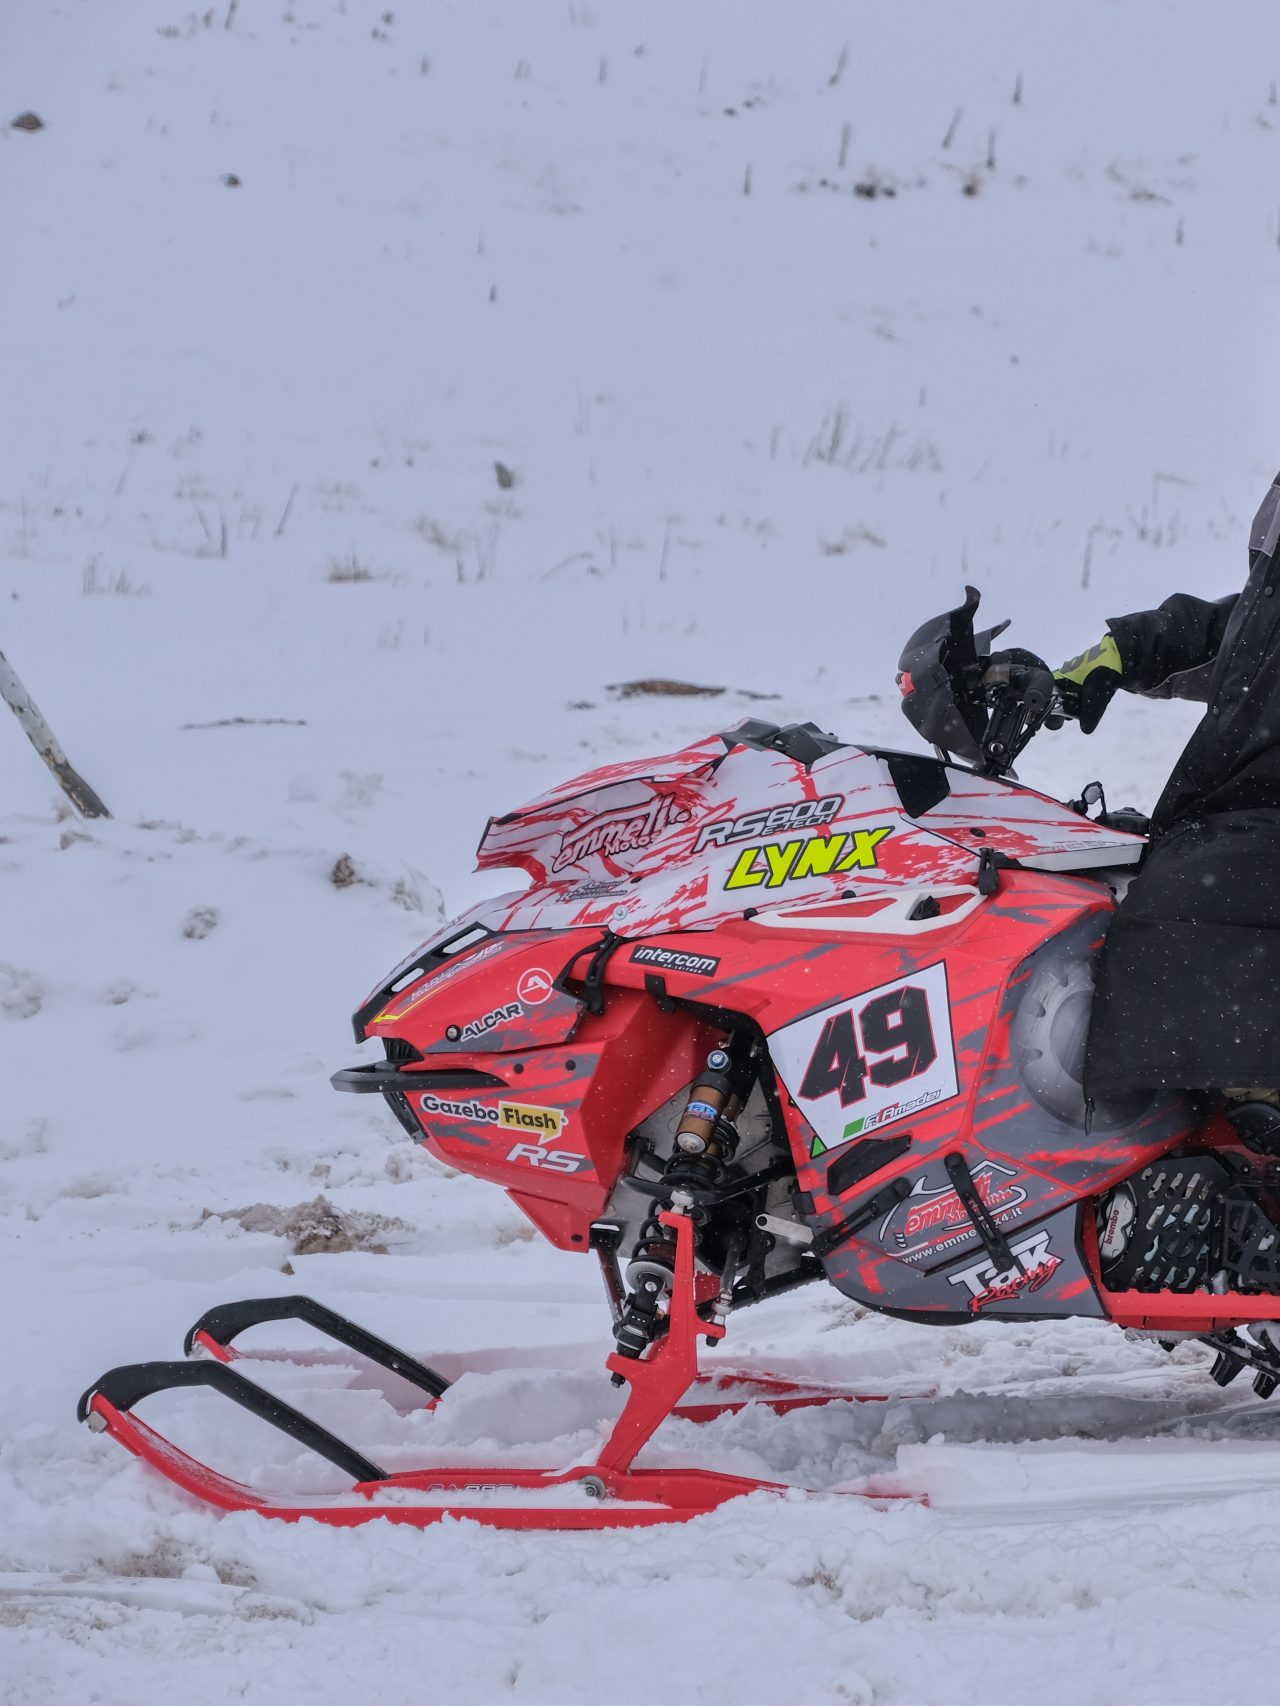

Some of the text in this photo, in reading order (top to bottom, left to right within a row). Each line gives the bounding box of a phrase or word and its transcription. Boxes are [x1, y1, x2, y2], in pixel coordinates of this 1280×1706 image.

[722, 826, 895, 891] LYNX
[634, 946, 717, 971] intercom
[461, 1002, 523, 1041] ALCAR
[797, 985, 938, 1109] 49
[422, 1095, 557, 1130] Gazebo Flash
[506, 1143, 586, 1173] RS
[1104, 1209, 1120, 1245] brembo
[967, 1257, 1058, 1313] Racing
